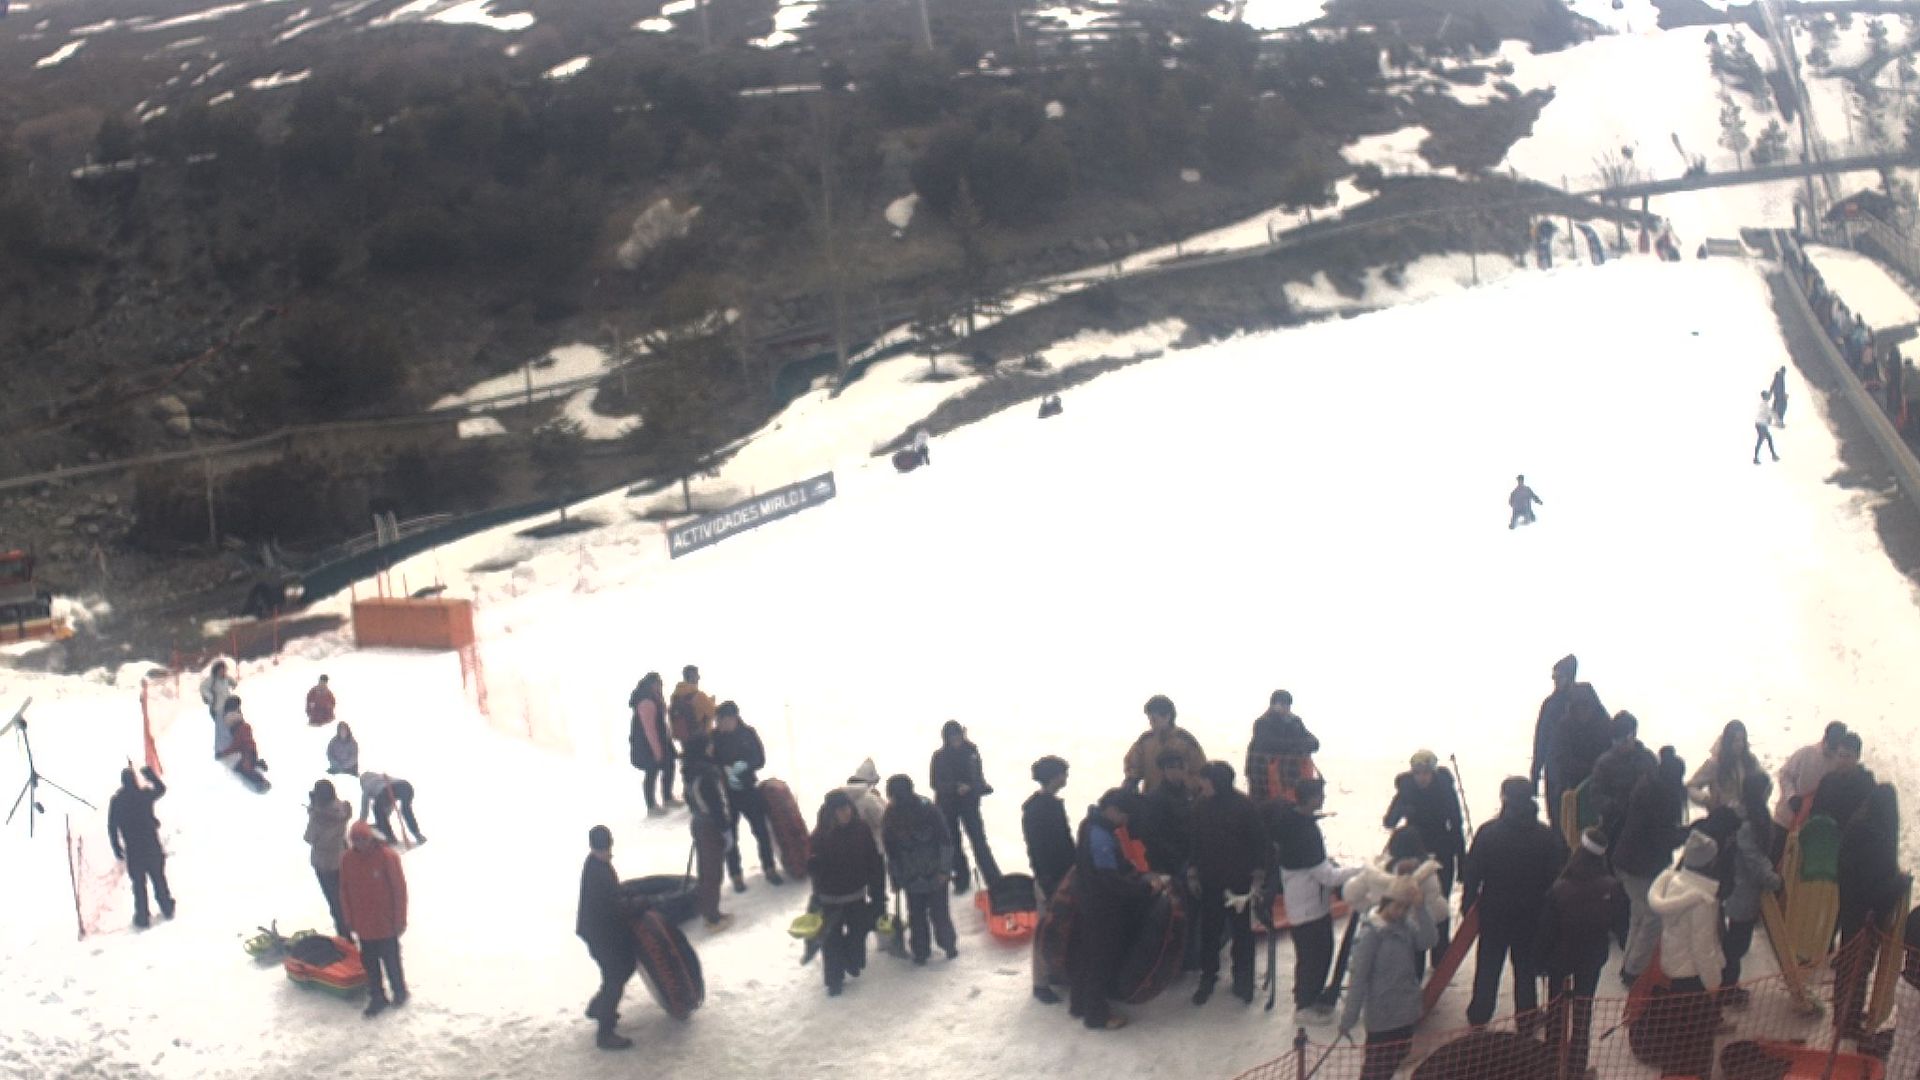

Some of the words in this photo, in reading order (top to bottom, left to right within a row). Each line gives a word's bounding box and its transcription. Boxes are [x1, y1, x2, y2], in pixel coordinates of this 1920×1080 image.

[673, 504, 759, 549] ACTIVIDADES
[760, 491, 799, 516] MIRLO
[800, 488, 807, 502] 1
